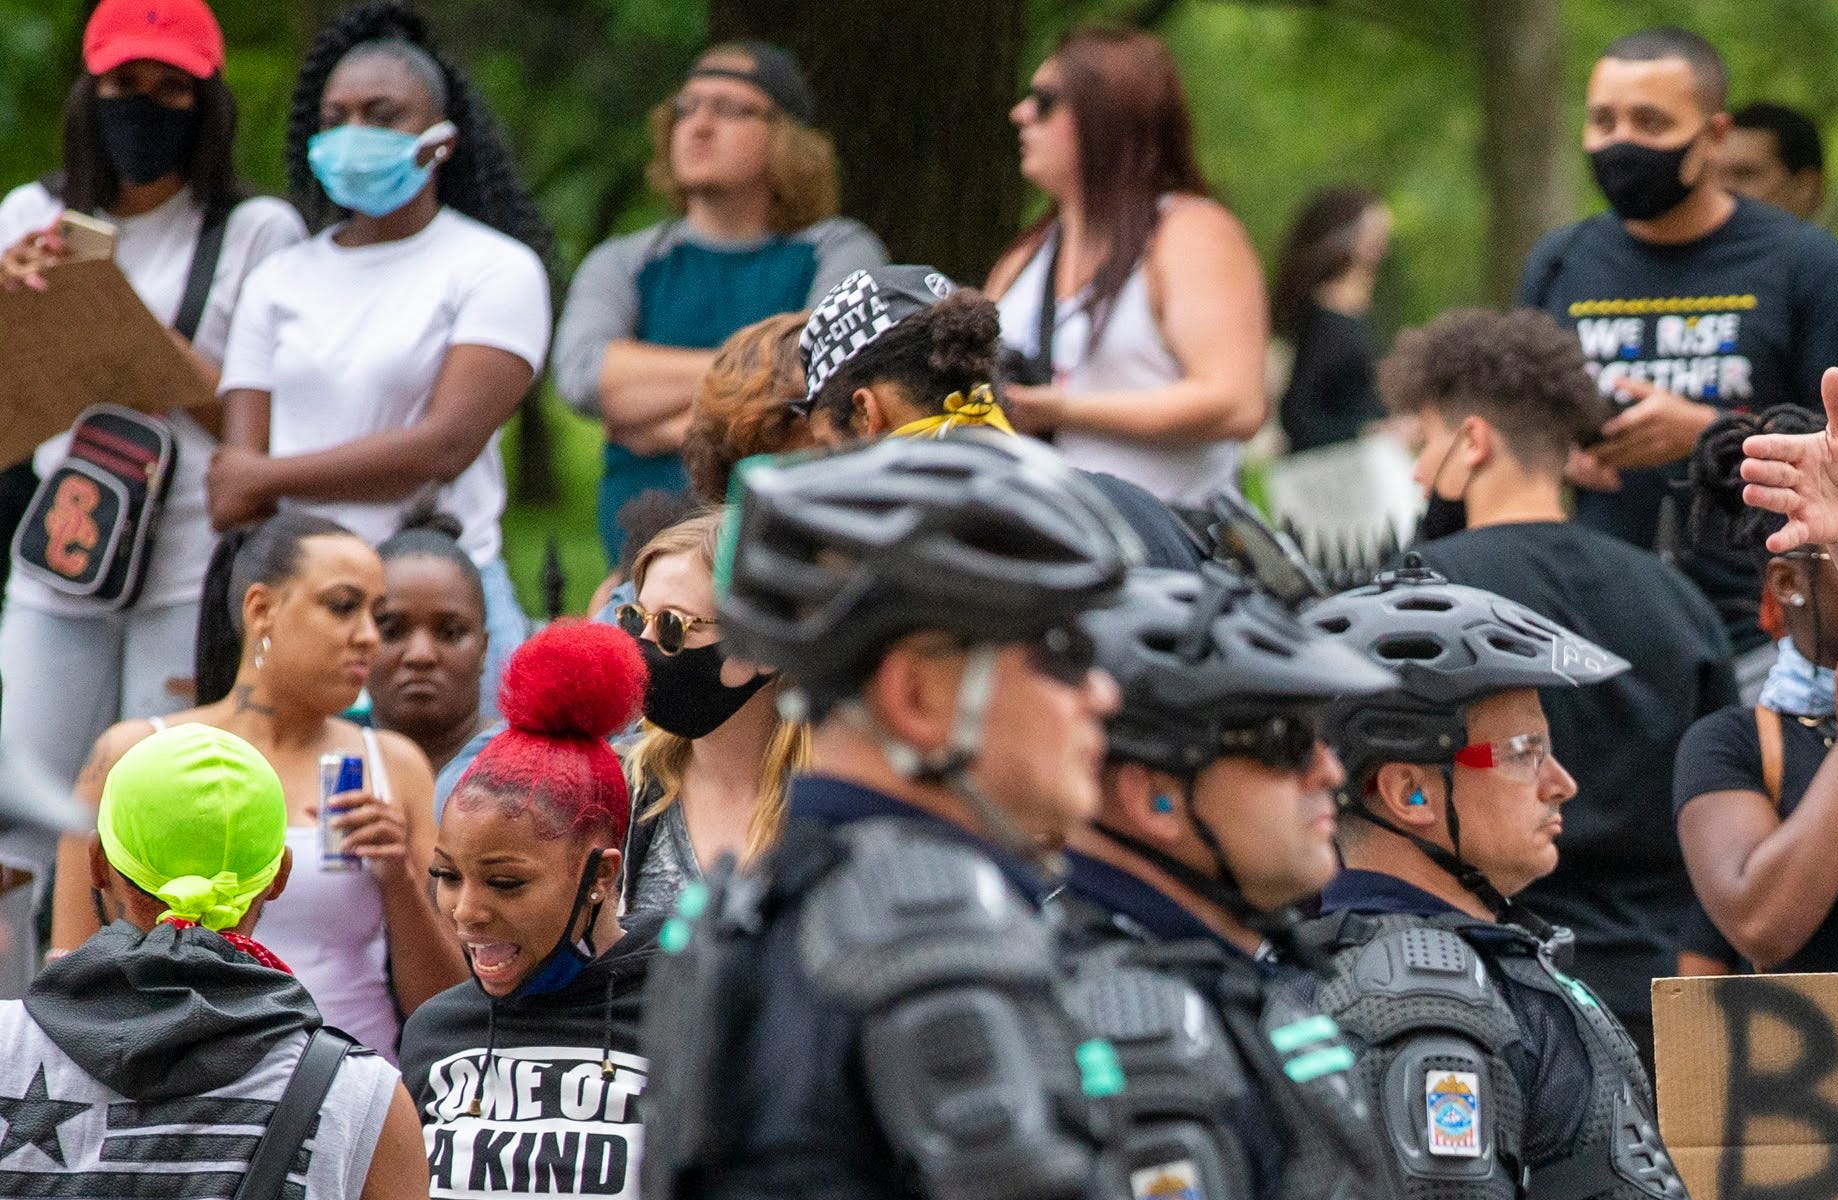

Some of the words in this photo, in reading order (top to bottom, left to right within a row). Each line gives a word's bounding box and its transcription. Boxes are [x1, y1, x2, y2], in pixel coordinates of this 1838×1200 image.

[1577, 318, 1646, 359] WE
[438, 1055, 553, 1123] ONE
[560, 1062, 648, 1123] OF
[427, 1128, 457, 1190] A
[468, 1128, 628, 1195] KIND
